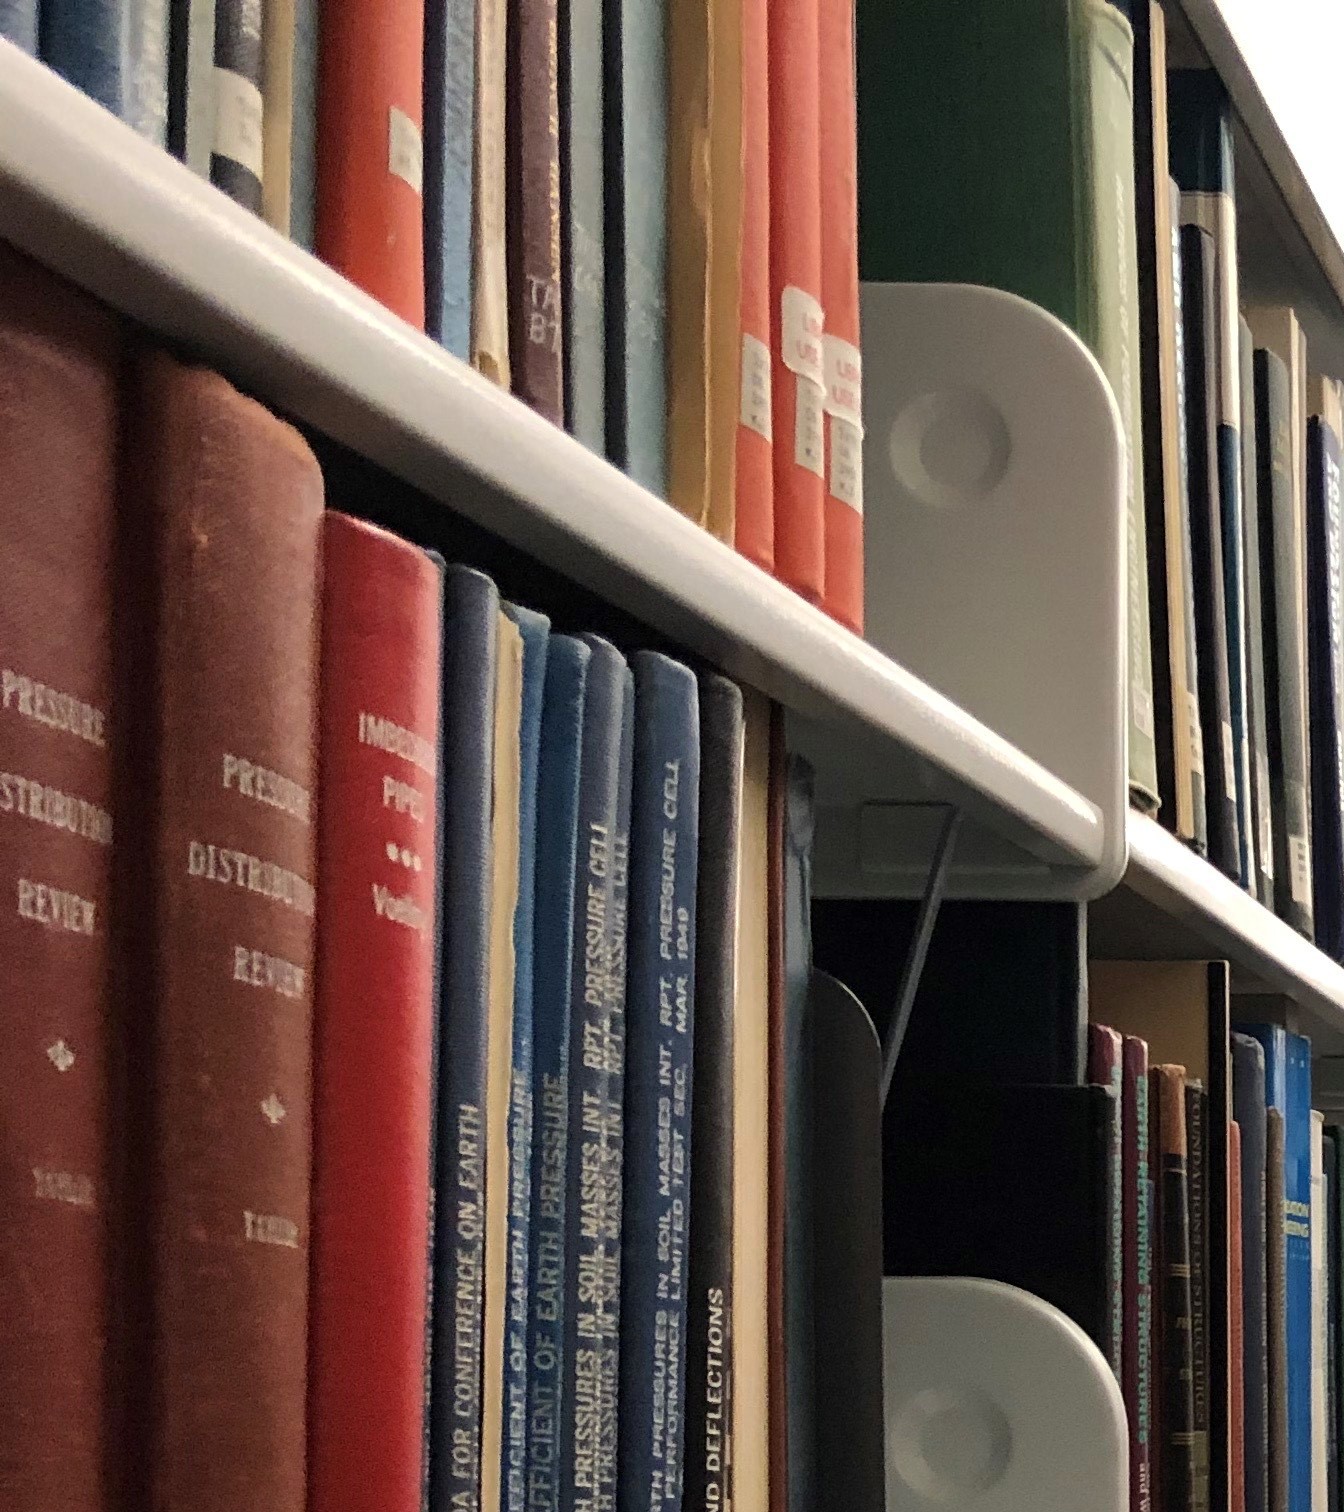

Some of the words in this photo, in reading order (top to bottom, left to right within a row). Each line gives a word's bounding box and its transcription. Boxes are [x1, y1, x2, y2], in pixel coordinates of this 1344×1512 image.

[1, 669, 106, 746] PRESSURE
[664, 759, 680, 819] CELL
[589, 822, 608, 877] CELL
[17, 878, 96, 935] REVIEW
[660, 828, 677, 959] PRESSURE
[232, 944, 304, 998] REVIEW
[585, 884, 607, 1006] PRESSURE
[457, 1105, 480, 1190] EARTH
[540, 1072, 567, 1219] PRESSURE
[657, 1099, 672, 1197] MASSES
[457, 1201, 479, 1239] ON
[579, 1143, 601, 1239] MASSES
[1136, 1161, 1149, 1285] RETAINING
[535, 1233, 560, 1321] EARTH
[578, 1254, 600, 1302] SOIL
[655, 1209, 671, 1261] SOIL
[669, 1199, 685, 1300] LIMITED
[578, 1314, 597, 1338] IN
[656, 1273, 670, 1299] IN
[453, 1247, 478, 1418] CONFERENCE
[534, 1333, 557, 1370] OF
[1136, 1293, 1150, 1444] STRUCTURES
[574, 1350, 598, 1488] PRESSURES
[651, 1311, 669, 1458] PRESSURES
[665, 1317, 682, 1498] PERFORMANCE
[706, 1287, 724, 1472] DEFLECTIONS
[452, 1428, 474, 1479] FOR
[1139, 1462, 1149, 1492] and
